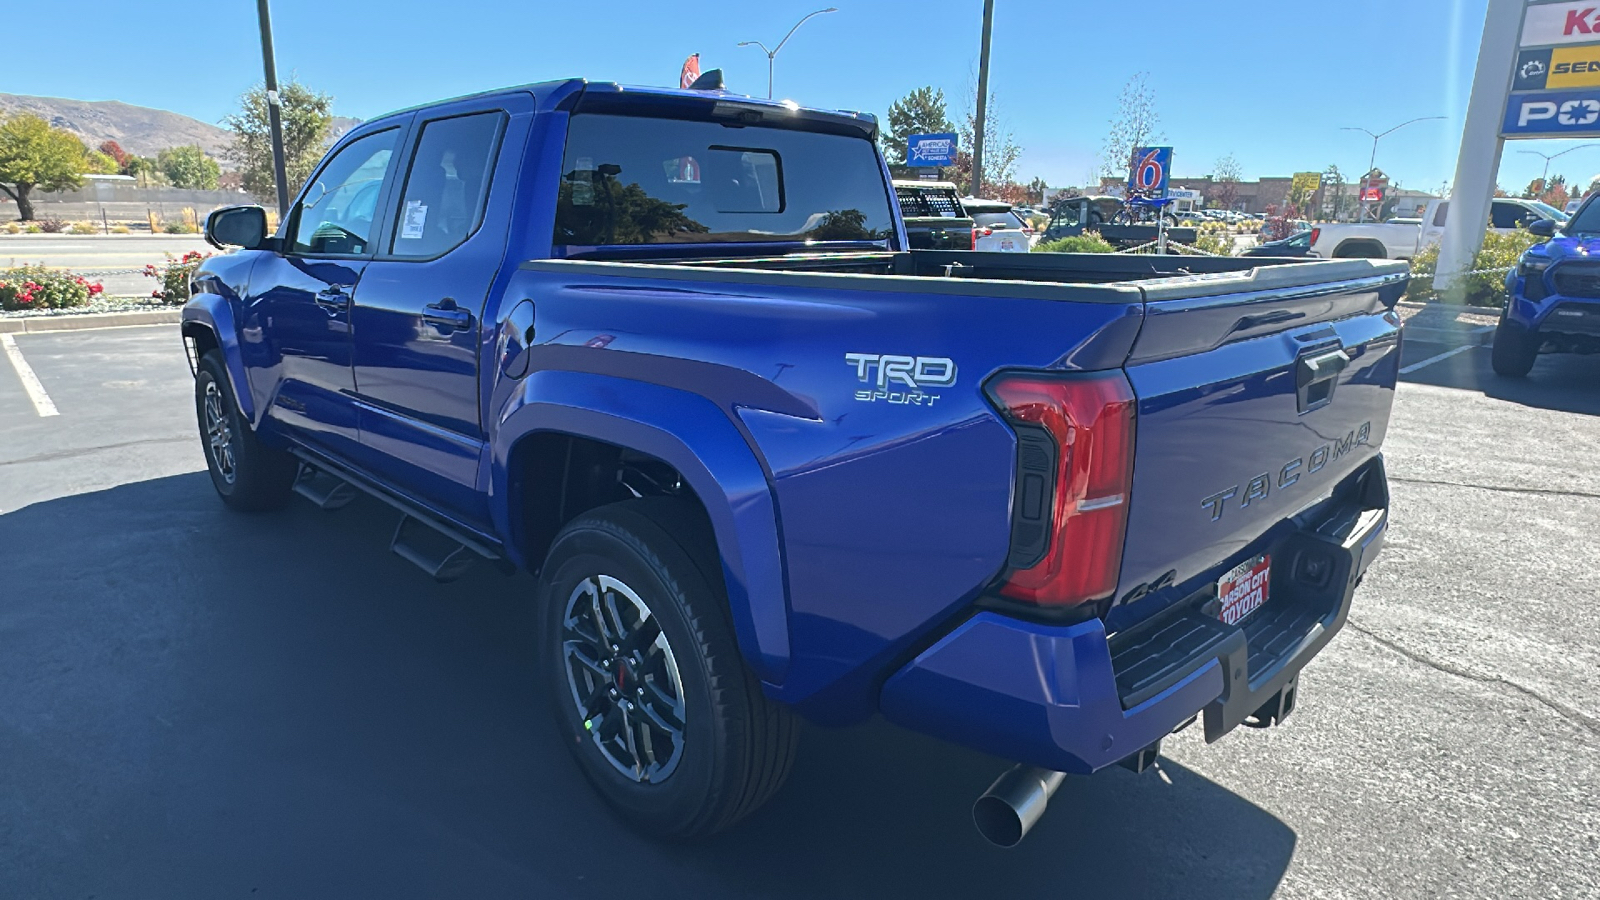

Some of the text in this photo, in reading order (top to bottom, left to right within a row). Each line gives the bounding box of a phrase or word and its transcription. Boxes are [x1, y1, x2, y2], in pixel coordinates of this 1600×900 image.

[1518, 100, 1600, 127] PO
[1137, 149, 1163, 190] 6
[845, 352, 957, 388] TRD
[855, 390, 940, 406] SPORT
[1202, 421, 1370, 522] TACOMA
[1252, 566, 1269, 590] CITY
[1223, 587, 1262, 626] TOYOTA
